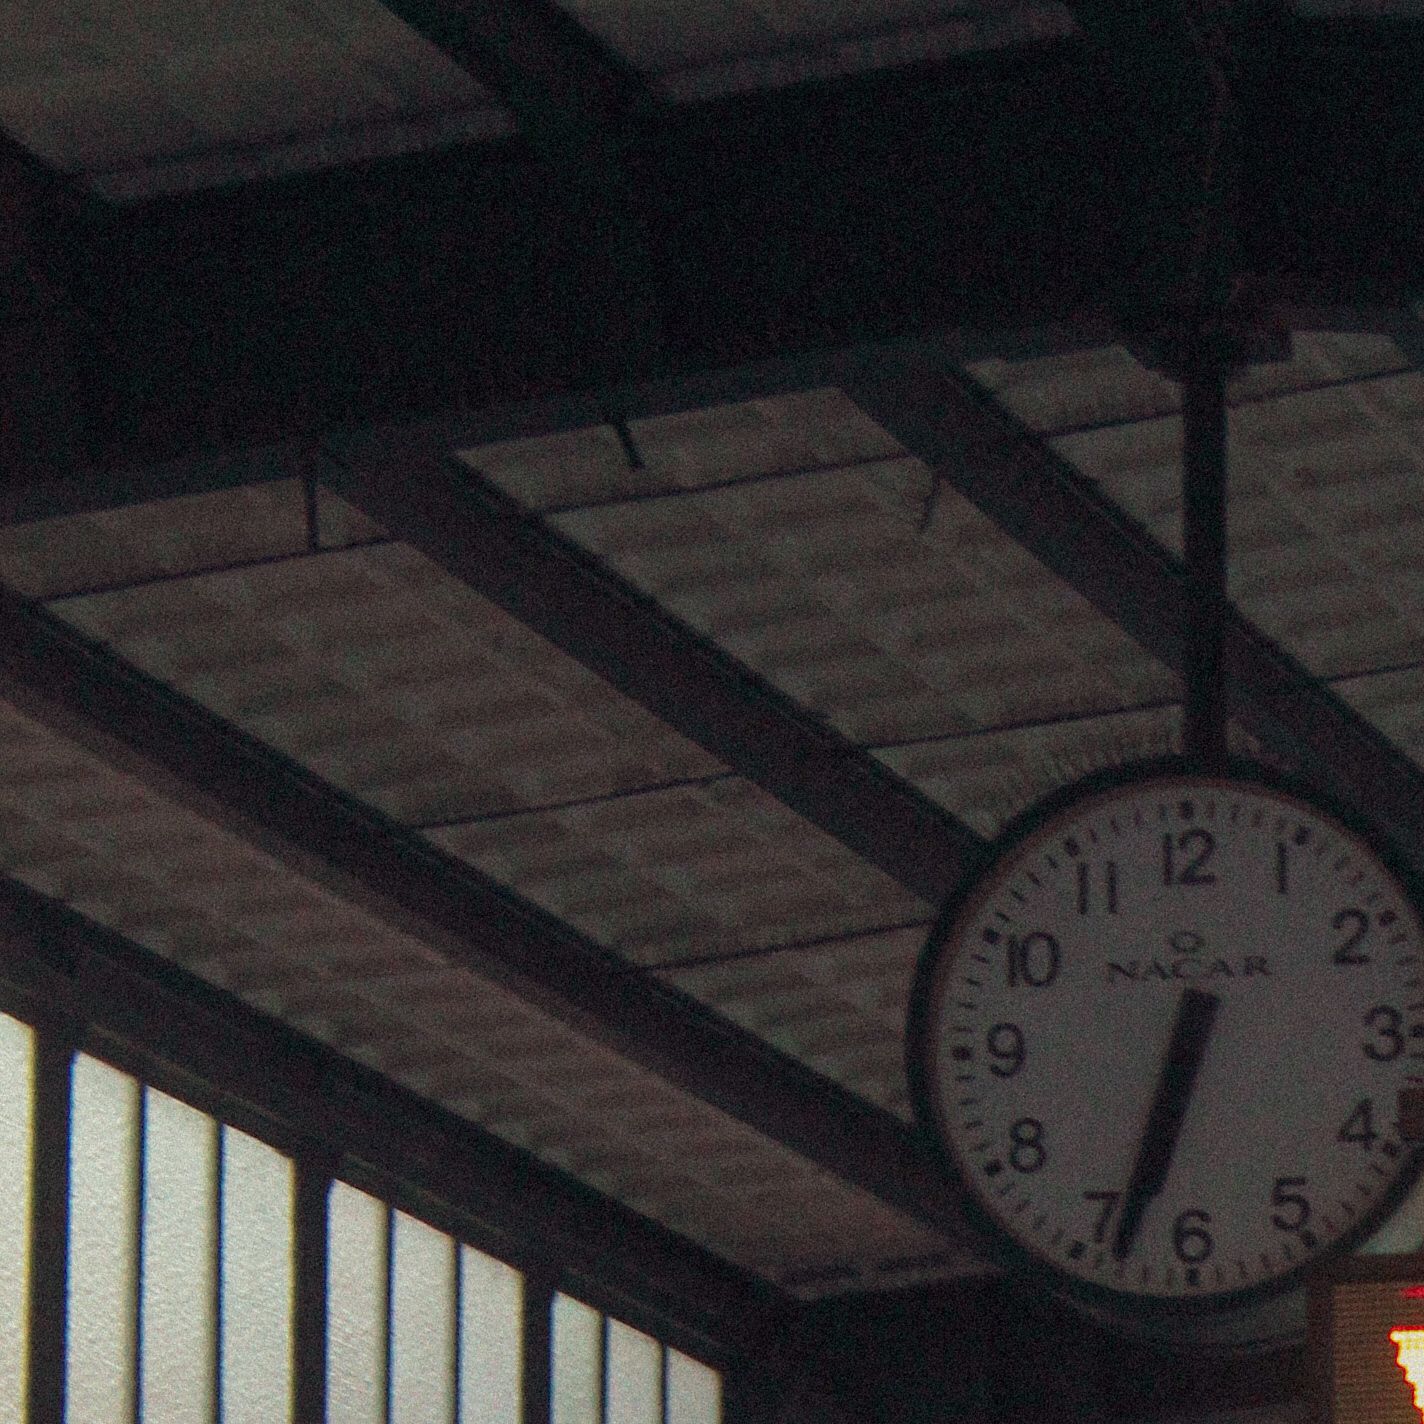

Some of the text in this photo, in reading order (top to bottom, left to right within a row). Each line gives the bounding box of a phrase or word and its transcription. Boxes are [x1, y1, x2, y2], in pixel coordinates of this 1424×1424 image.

[1163, 829, 1216, 887] 12
[1276, 841, 1288, 895] 1
[1078, 861, 1119, 915] 11
[1006, 931, 1061, 988] 10
[1331, 908, 1370, 966] 2
[986, 1022, 1026, 1078] 9
[1362, 1004, 1404, 1062] 3
[1008, 1116, 1047, 1174] 8
[1337, 1098, 1379, 1153] 4
[1083, 1190, 1121, 1244] 7
[1271, 1176, 1312, 1232] 5
[1174, 1208, 1216, 1265] 6
